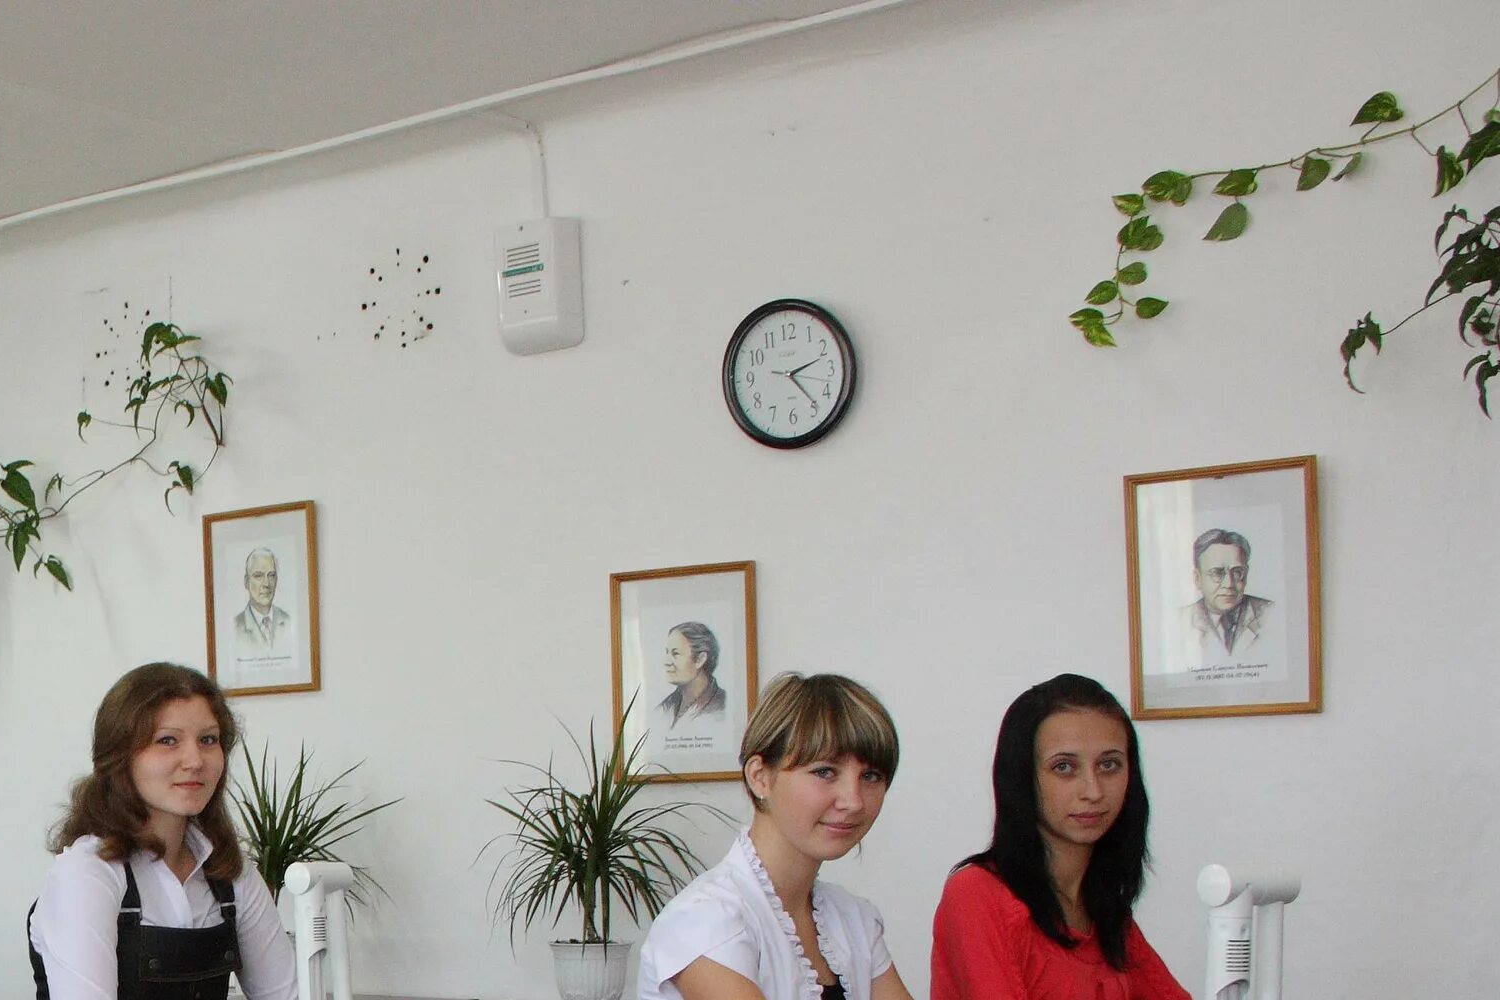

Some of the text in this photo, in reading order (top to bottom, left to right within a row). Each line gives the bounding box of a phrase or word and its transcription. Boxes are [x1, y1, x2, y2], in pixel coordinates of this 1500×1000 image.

[764, 332, 775, 349] 11
[781, 323, 796, 341] 12
[807, 326, 812, 342] 1
[819, 339, 827, 356] 2
[750, 348, 764, 366] 10
[827, 360, 835, 377] 3
[746, 372, 754, 388] 9
[822, 383, 831, 399] 4
[753, 393, 761, 408] 8
[810, 400, 818, 417] 5
[769, 406, 777, 423] 7
[789, 408, 798, 424] 6
